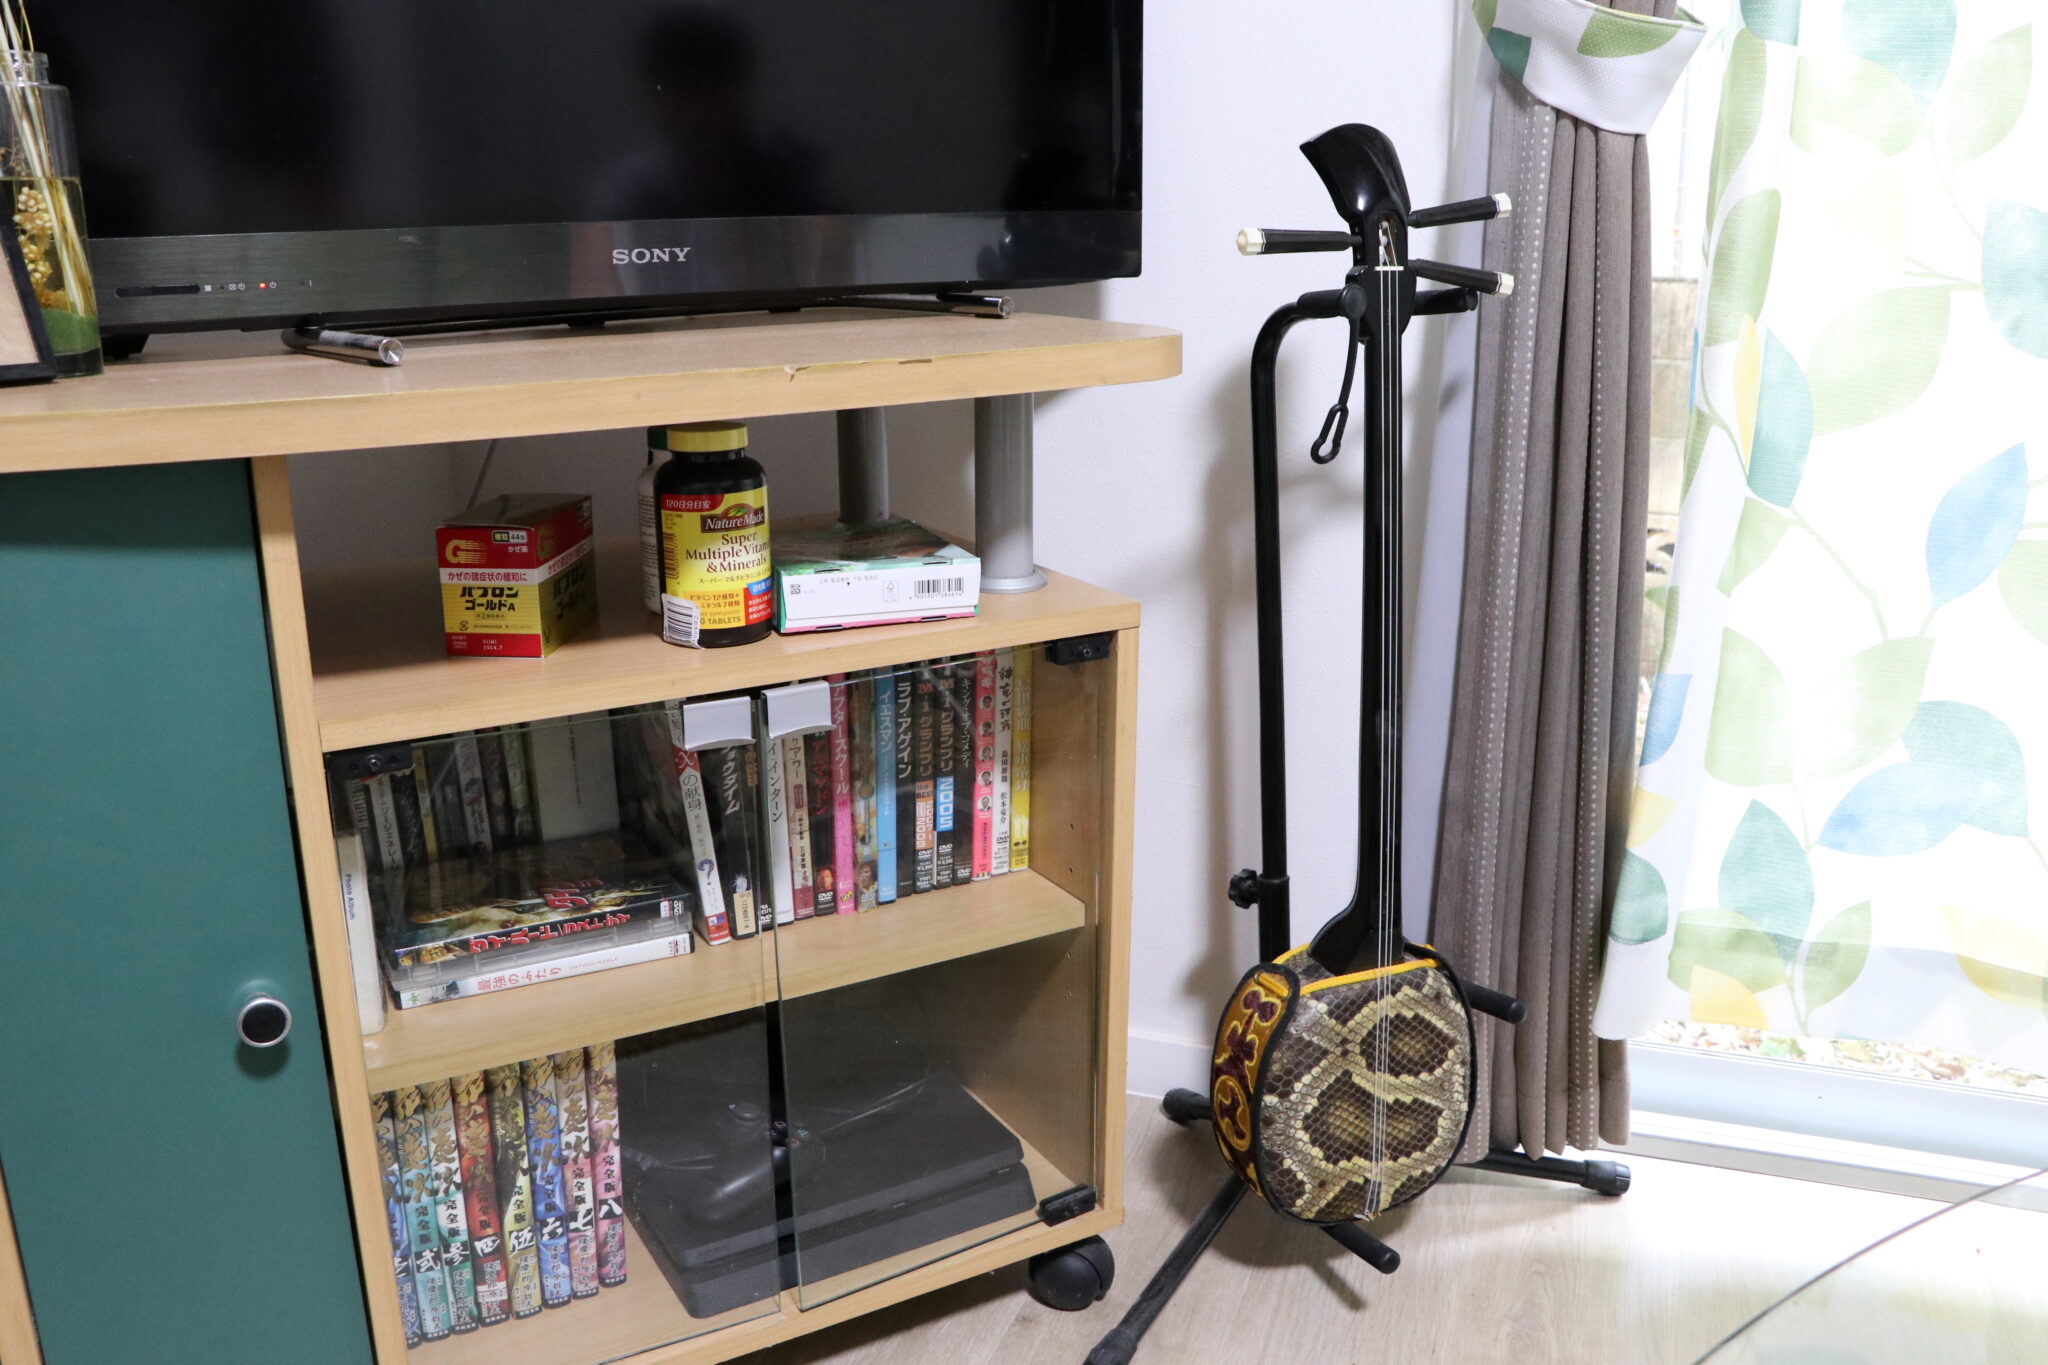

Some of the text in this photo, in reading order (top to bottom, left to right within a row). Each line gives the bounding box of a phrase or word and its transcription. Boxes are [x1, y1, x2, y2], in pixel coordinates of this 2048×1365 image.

[612, 247, 691, 264] SONY
[665, 499, 711, 508] 120日分目安
[704, 510, 765, 530] Nature Made
[721, 531, 758, 546] Super
[685, 545, 743, 562] Multiple
[447, 571, 528, 582] かぜの諸症状の緩和に
[459, 586, 519, 598] パブロン
[464, 599, 516, 612] ゴールドA
[707, 616, 742, 625] TABLETS
[879, 690, 893, 753] イエスマン
[897, 682, 912, 779] ラブ・アゲイン
[961, 678, 972, 769] キング・オブ・コメディ
[939, 777, 953, 829] 2005
[477, 967, 561, 991] 最強のふたり
[572, 1167, 587, 1206] 完全版
[602, 1155, 617, 1193] 完全版
[512, 1185, 527, 1224] 完全版
[599, 1199, 623, 1219] 八
[444, 1198, 461, 1239] 完全版
[542, 1216, 564, 1242] 六
[568, 1204, 594, 1232] 七
[474, 1236, 501, 1257] 四
[509, 1226, 536, 1258] 伍
[416, 1247, 441, 1273] 弐
